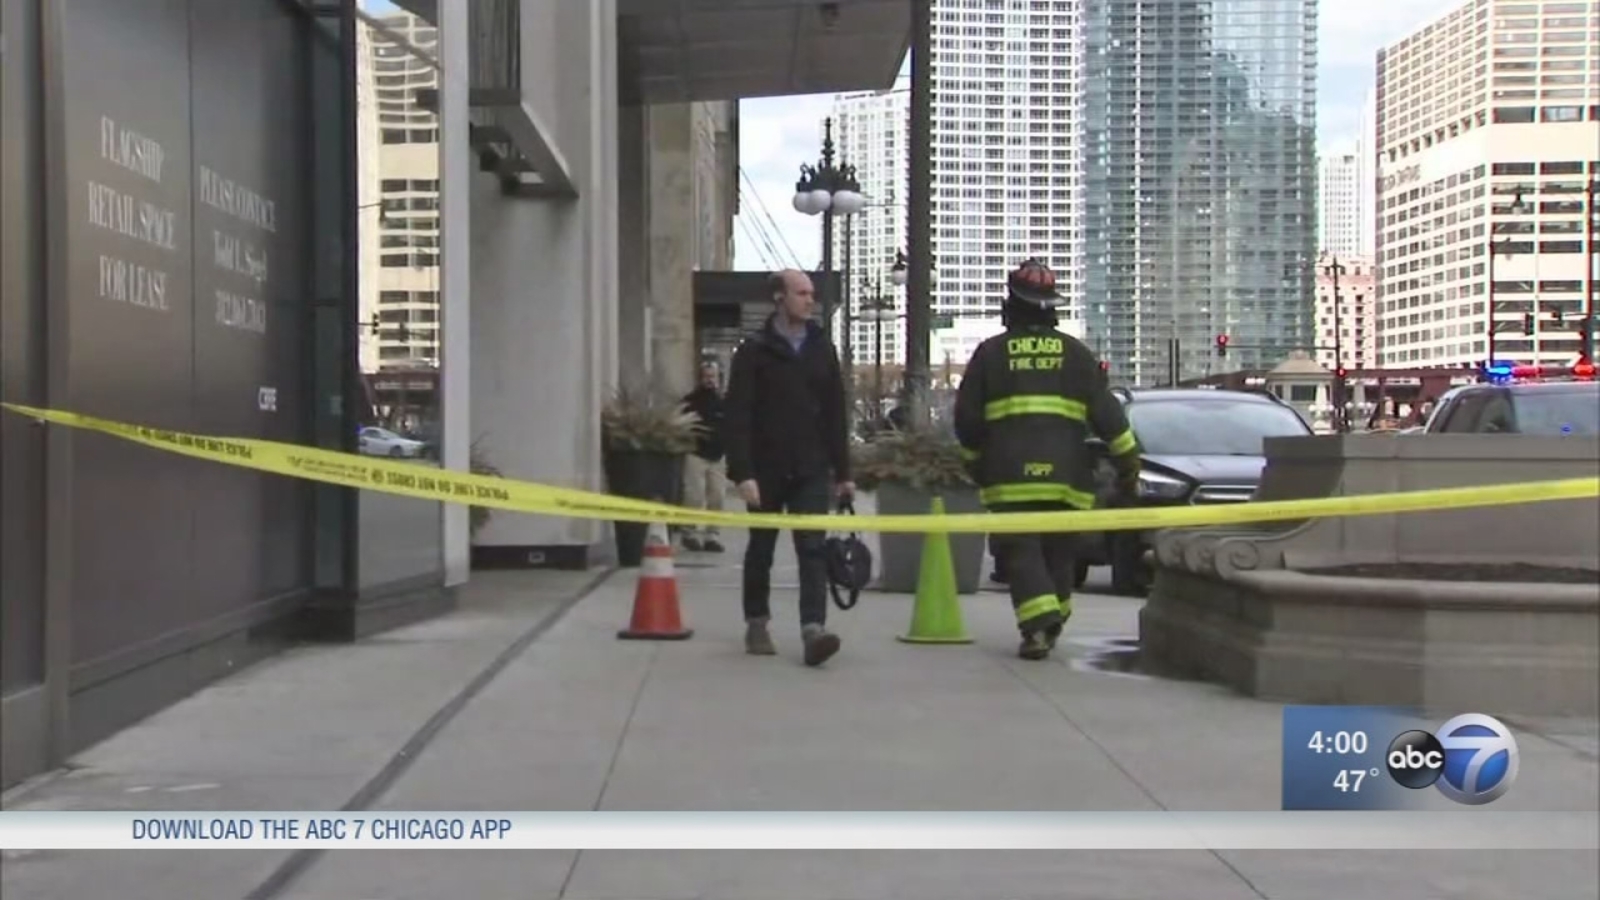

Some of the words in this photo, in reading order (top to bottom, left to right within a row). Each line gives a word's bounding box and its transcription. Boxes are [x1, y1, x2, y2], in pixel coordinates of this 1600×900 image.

[101, 115, 164, 183] FLAGSHIP
[88, 181, 138, 238] RETAIL
[138, 202, 175, 249] SPACE
[99, 255, 127, 301] FOR
[129, 263, 169, 311] LEASE
[1008, 337, 1064, 355] CHICAGO
[1009, 357, 1034, 371] FIRE
[1035, 357, 1064, 370] DEPT
[475, 485, 509, 502] POLICE
